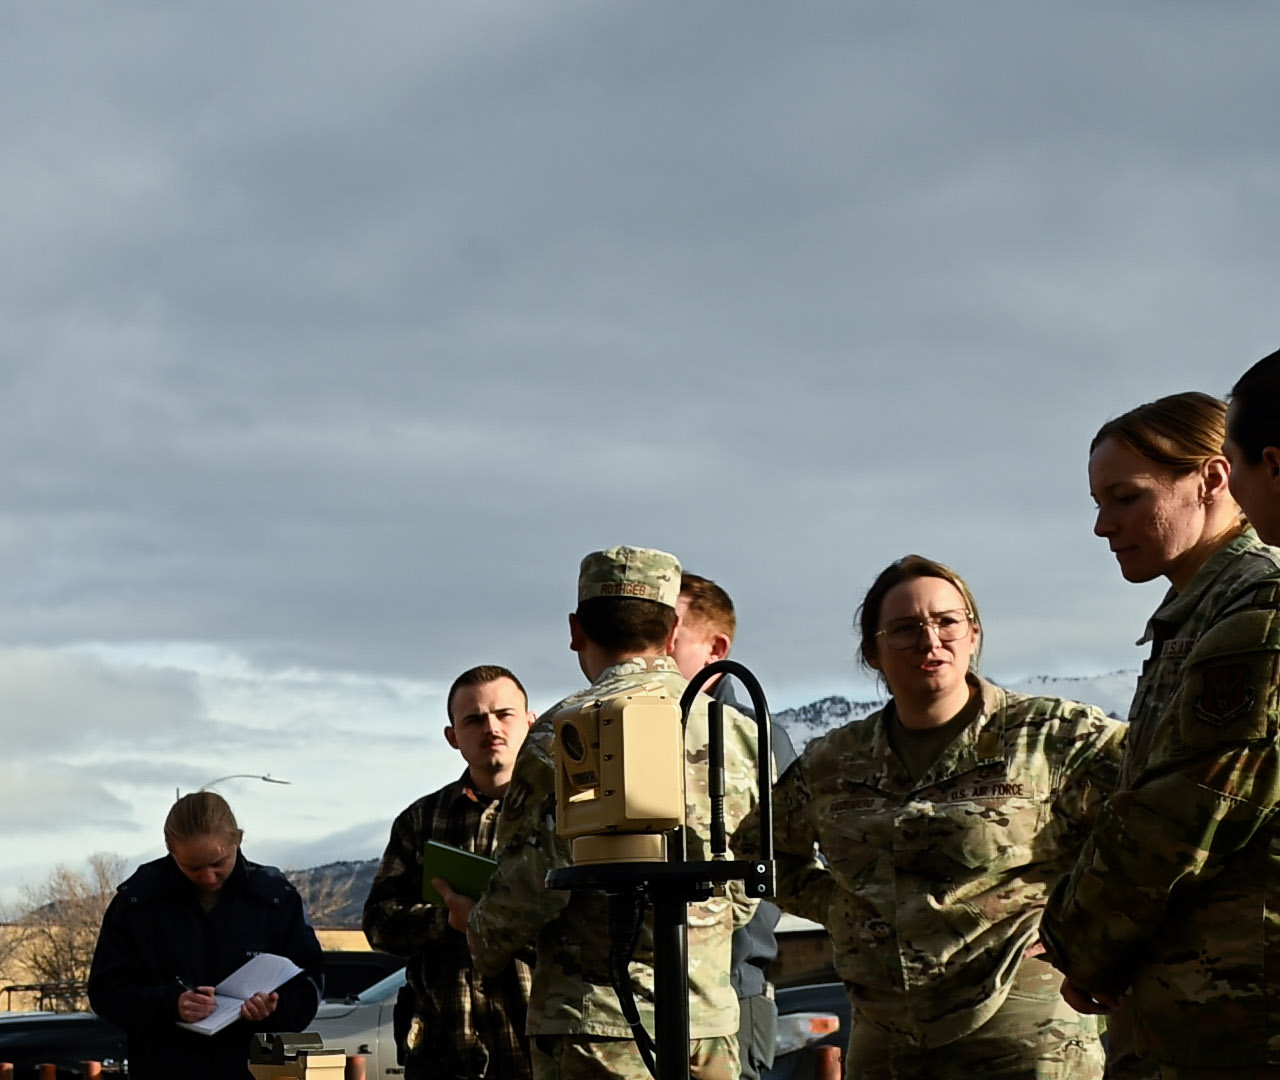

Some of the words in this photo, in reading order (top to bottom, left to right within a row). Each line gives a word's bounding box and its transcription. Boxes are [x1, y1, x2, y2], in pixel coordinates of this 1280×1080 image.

[599, 582, 646, 596] ROTHGEB
[972, 786, 988, 797] AIR
[992, 783, 1025, 796] FORCE
